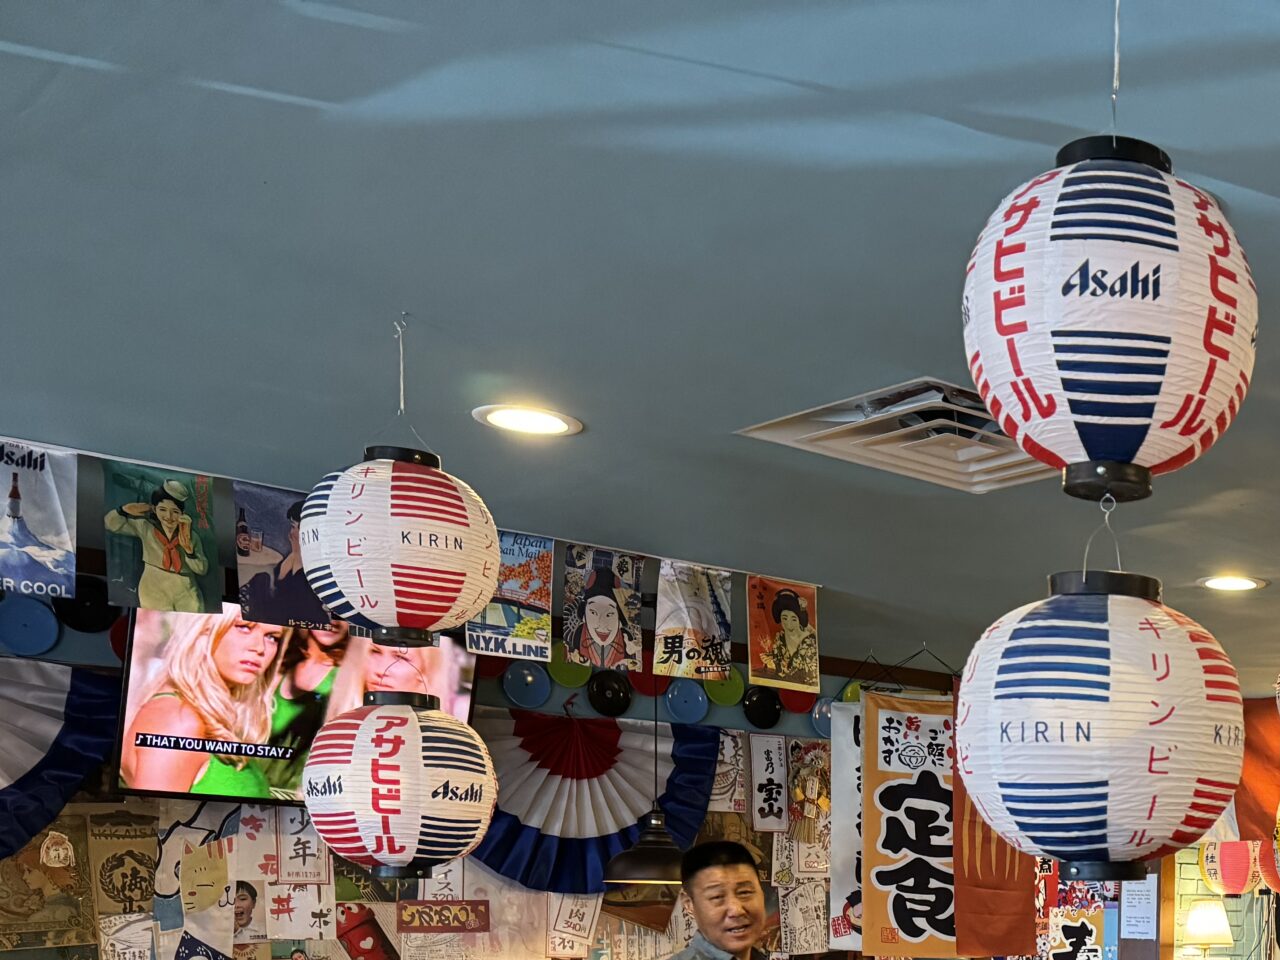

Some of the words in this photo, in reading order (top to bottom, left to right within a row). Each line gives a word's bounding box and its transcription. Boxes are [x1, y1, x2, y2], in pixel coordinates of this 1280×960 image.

[1062, 258, 1162, 301] Asahi
[301, 528, 320, 546] RIN
[345, 466, 379, 609] キリンビール
[401, 530, 464, 551] KIRIN
[20, 580, 72, 598] COOL
[881, 716, 903, 767] おかず
[1000, 721, 1092, 744] KIRIN
[1127, 617, 1178, 847] キリンビール
[1213, 724, 1245, 746] KIR
[146, 735, 177, 748] THAT
[178, 737, 203, 750] YOU
[205, 740, 239, 754] WANT
[240, 743, 255, 755] TO
[256, 745, 285, 758] STAY
[306, 775, 344, 799] Asahi
[371, 715, 409, 855] アサヒビール
[431, 779, 483, 803] Asahi
[874, 769, 956, 938] 定食
